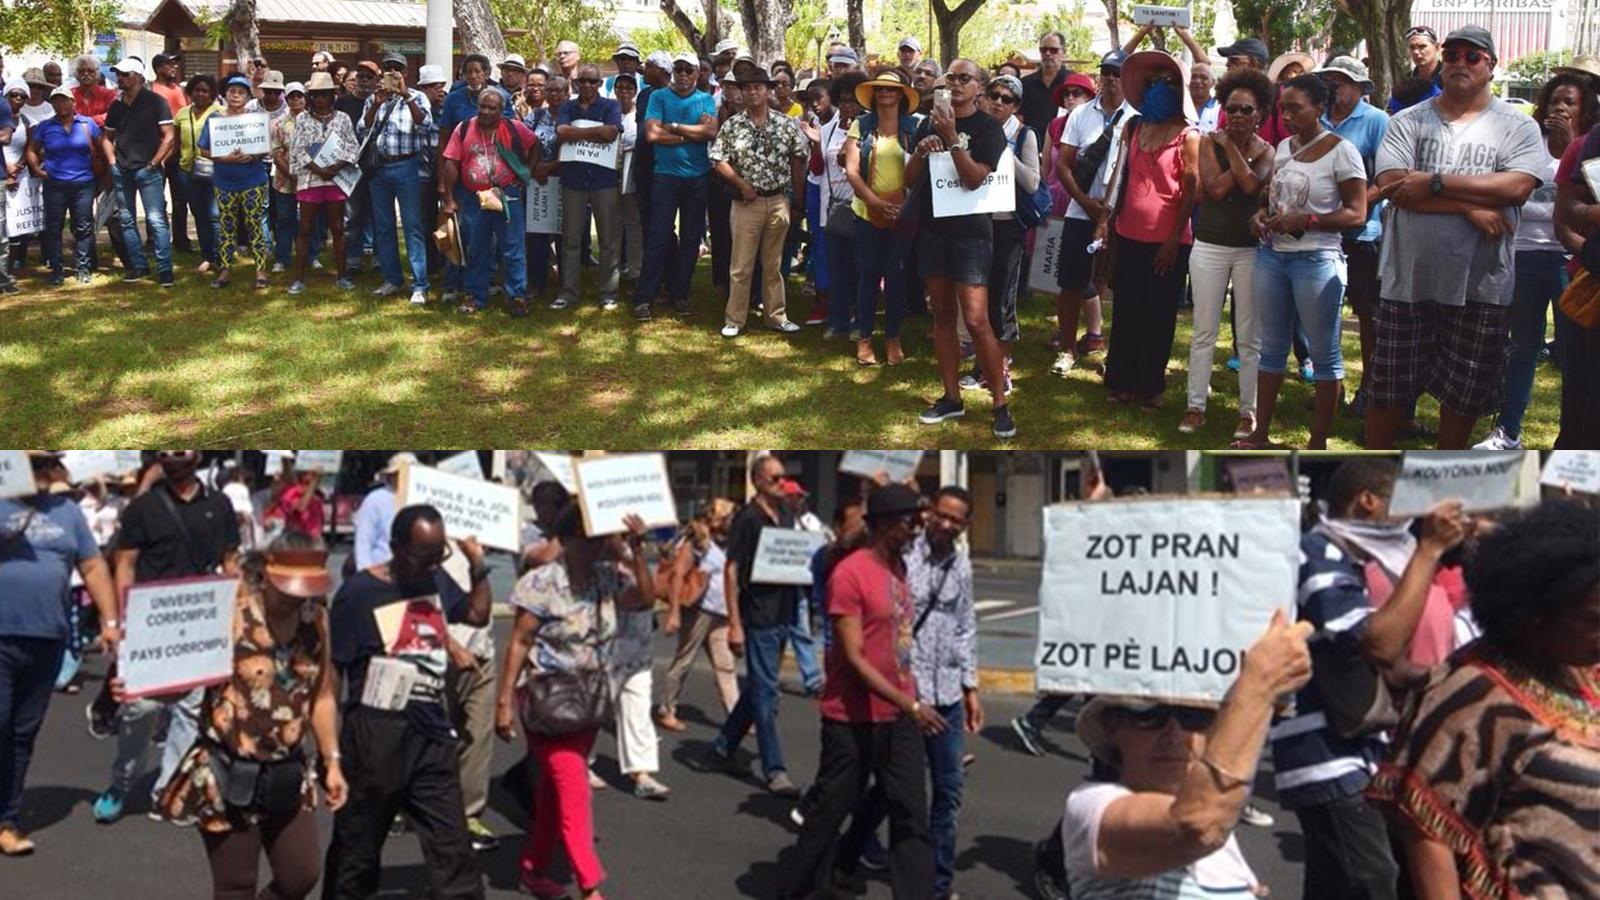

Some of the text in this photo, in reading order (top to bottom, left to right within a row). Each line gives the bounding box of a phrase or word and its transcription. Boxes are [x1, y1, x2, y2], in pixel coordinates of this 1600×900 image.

[588, 150, 600, 159] PA
[1086, 533, 1239, 560] ZOT PRAN
[1101, 571, 1219, 596] LAJAN !
[146, 606, 218, 627] CORROMPUE
[130, 637, 229, 662] PAYS CORROMPU
[1041, 642, 1096, 667] ZOT
[1104, 637, 1141, 669] PÈ
